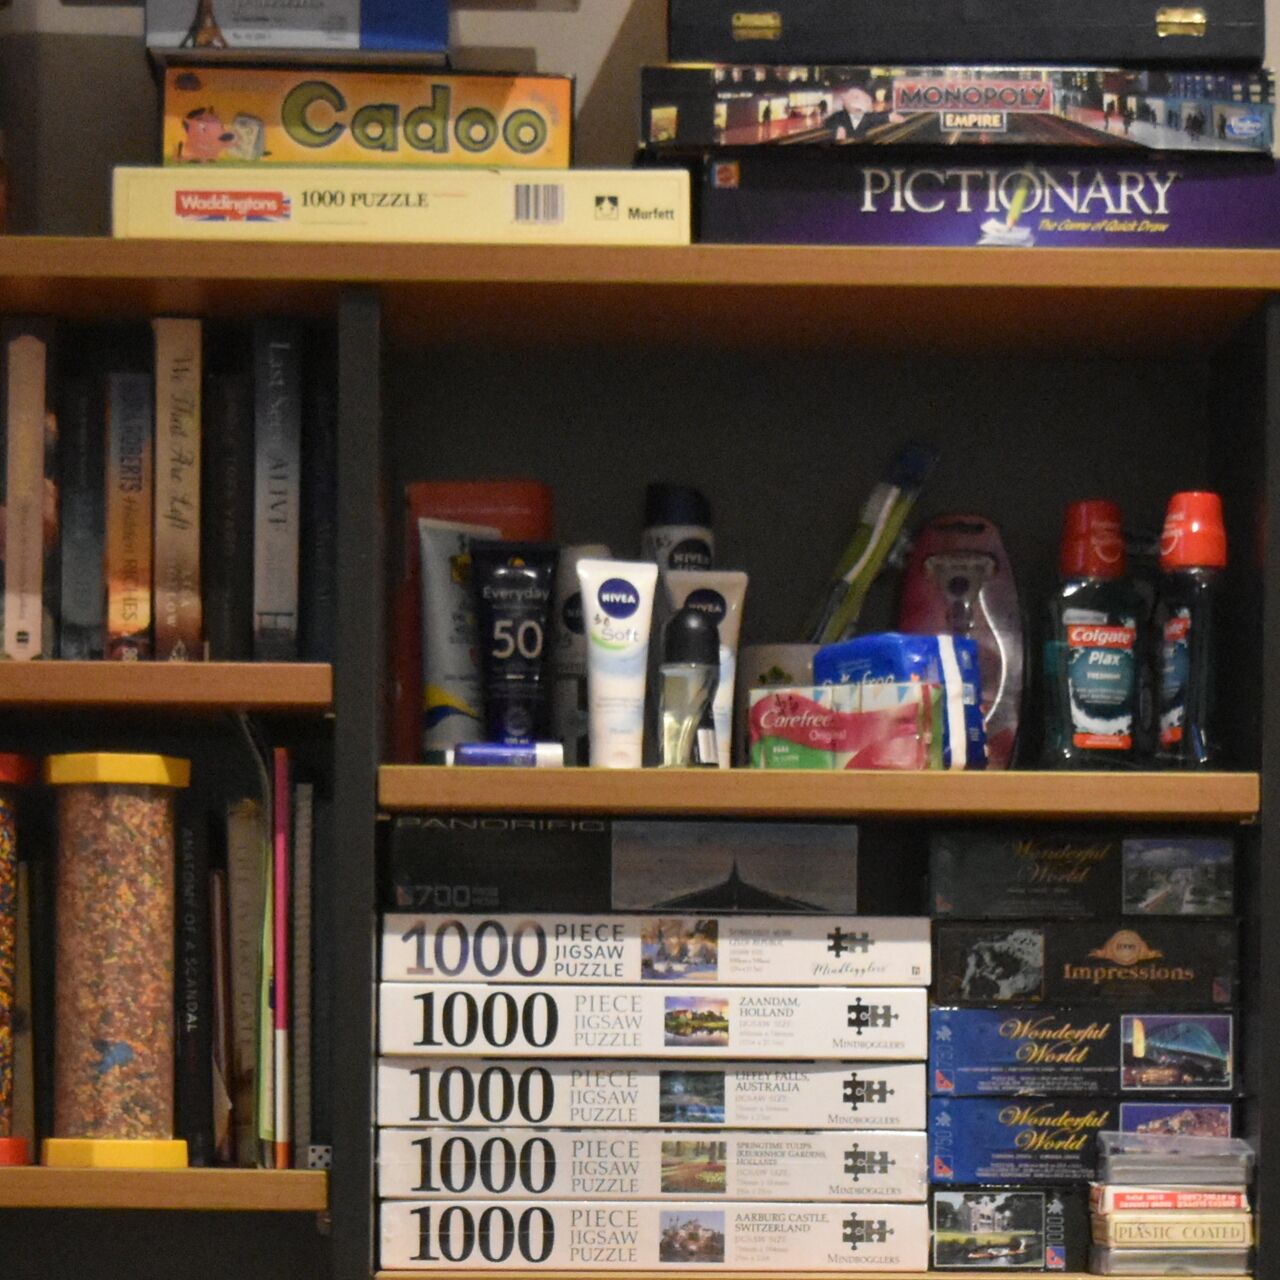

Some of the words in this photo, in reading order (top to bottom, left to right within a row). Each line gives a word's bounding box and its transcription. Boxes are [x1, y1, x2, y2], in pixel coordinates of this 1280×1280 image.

[899, 85, 1050, 111] MONOPOLY
[281, 80, 547, 154] Cadoo
[945, 113, 1003, 130] EMPIRE
[301, 190, 345, 207] 1000
[350, 193, 429, 208] PUZZLE
[860, 167, 1179, 216] PICTIONARY
[177, 194, 278, 217] Waddingtons
[628, 206, 675, 222] Murfett
[1039, 219, 1057, 231] The
[1058, 220, 1089, 231] Game
[1106, 220, 1137, 232] Quick
[1137, 221, 1169, 232] Draw
[482, 585, 550, 602] Everyday
[600, 592, 637, 604] NIVEA
[491, 620, 543, 660] 50
[602, 627, 640, 642] Soft
[1072, 627, 1131, 646] Colgate
[1088, 651, 1120, 666] Plax
[760, 711, 832, 729] Carefree
[1013, 841, 1112, 862] Wonderful
[1018, 864, 1088, 883] World
[554, 924, 625, 943] PIECE
[401, 920, 548, 978] 1000
[554, 944, 625, 962] JIGSAW
[554, 961, 625, 978] PUZZLE
[1063, 963, 1196, 984] Impressions
[184, 957, 199, 1032] SCANDAL
[573, 995, 642, 1013] PIECE
[738, 1007, 795, 1018] HOLLAND
[412, 990, 559, 1047] 1000
[573, 1014, 642, 1030] JIGSAW
[999, 1016, 1111, 1042] Wonderful
[573, 1032, 642, 1048] PUZZLE
[1016, 1042, 1091, 1064] World
[569, 1069, 639, 1088] PIECE
[735, 1082, 801, 1093] AUSTRALIA
[408, 1066, 555, 1123] 1000
[569, 1090, 639, 1107] JIGSAW
[569, 1107, 639, 1123] PUZZLE
[826, 1113, 901, 1125] MINDBOGGLERS
[998, 1103, 1110, 1128] Wonderful
[571, 1140, 641, 1159] PIECE
[1014, 1130, 1088, 1151] World
[409, 1136, 556, 1194] 1000
[571, 1161, 641, 1178] JIGSAW
[571, 1178, 641, 1194] PUZZLE
[828, 1184, 902, 1196] MINDBOGGLERS
[569, 1209, 639, 1228] PIECE
[408, 1205, 555, 1263] 1000
[735, 1223, 811, 1233] SWITZERLAND
[1119, 1225, 1173, 1240] PLASTIC
[1182, 1224, 1241, 1240] COATED
[569, 1231, 639, 1247] JIGSAW
[569, 1246, 639, 1263] PUZZLE
[826, 1253, 900, 1265] MINDBOGGLERS
